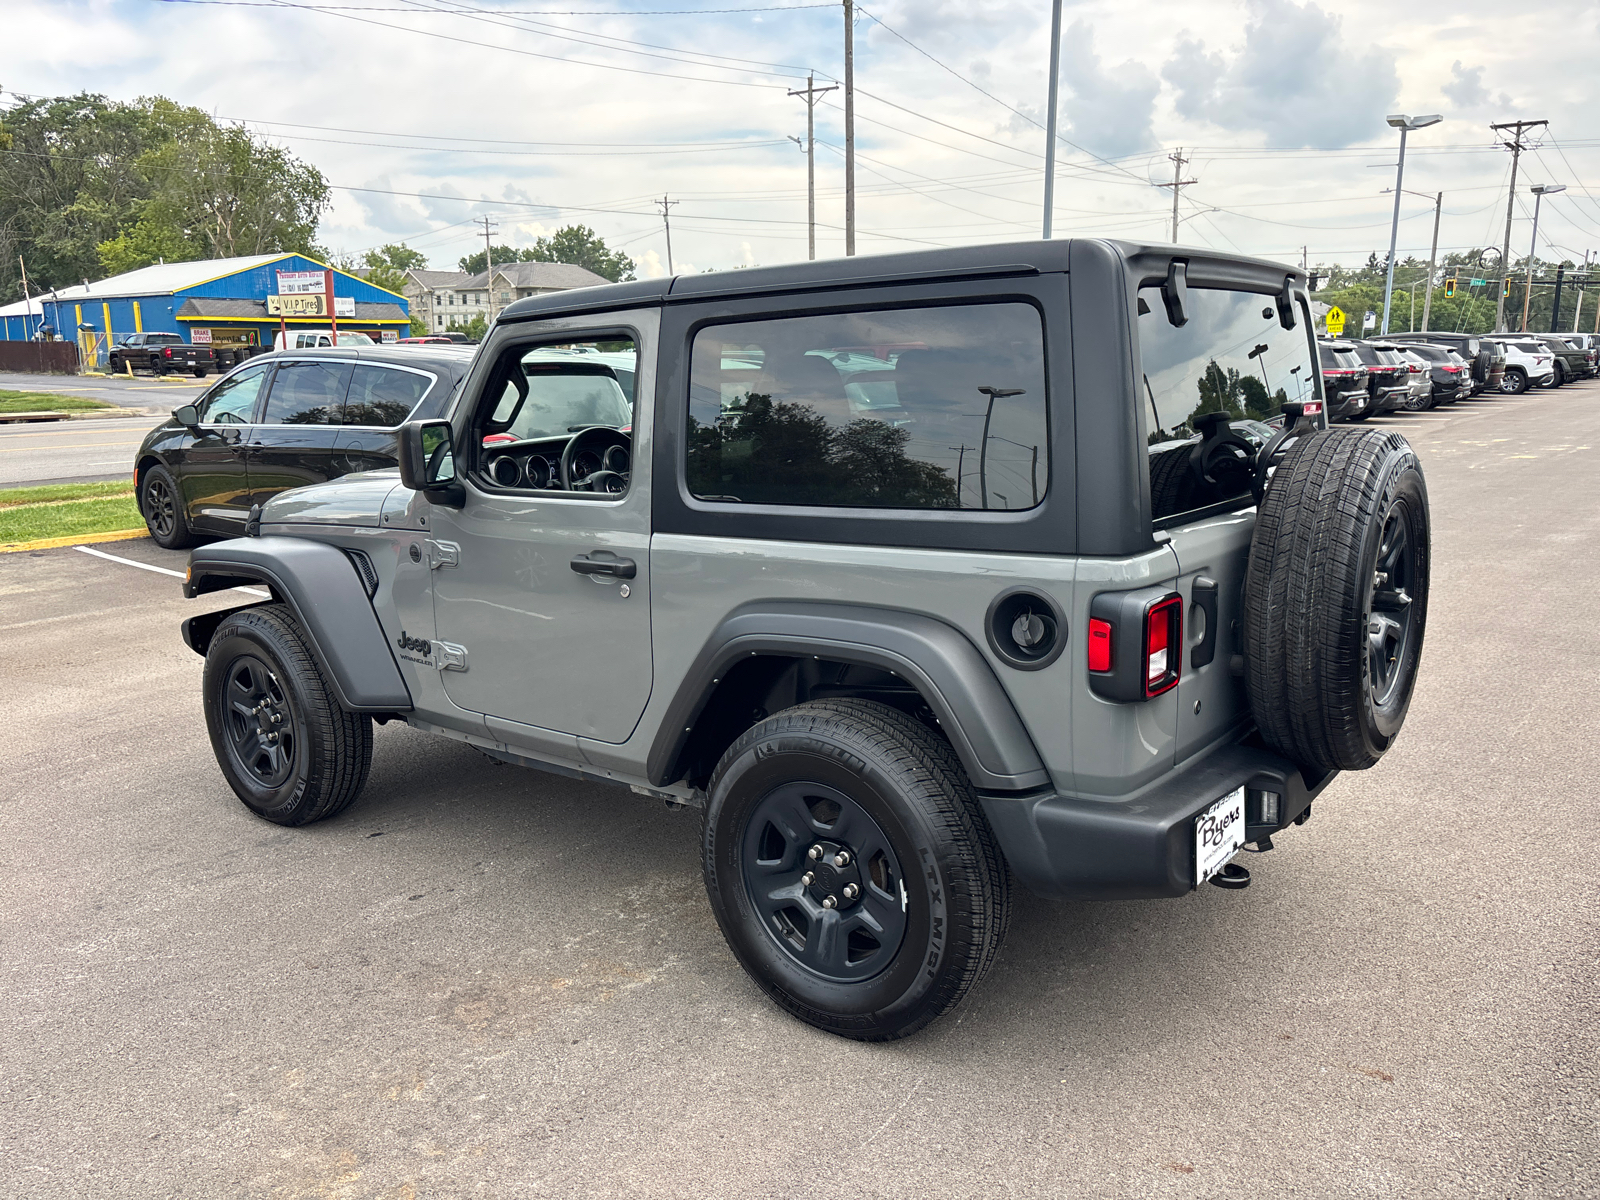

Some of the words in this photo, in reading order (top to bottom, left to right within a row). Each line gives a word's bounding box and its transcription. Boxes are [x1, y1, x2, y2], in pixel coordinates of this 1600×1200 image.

[283, 299, 299, 310] V.I.P
[300, 299, 317, 309] Tires
[397, 630, 432, 658] Jeep
[400, 653, 433, 667] WRANGLER
[1198, 806, 1240, 847] Byers
[918, 847, 943, 905] LTX
